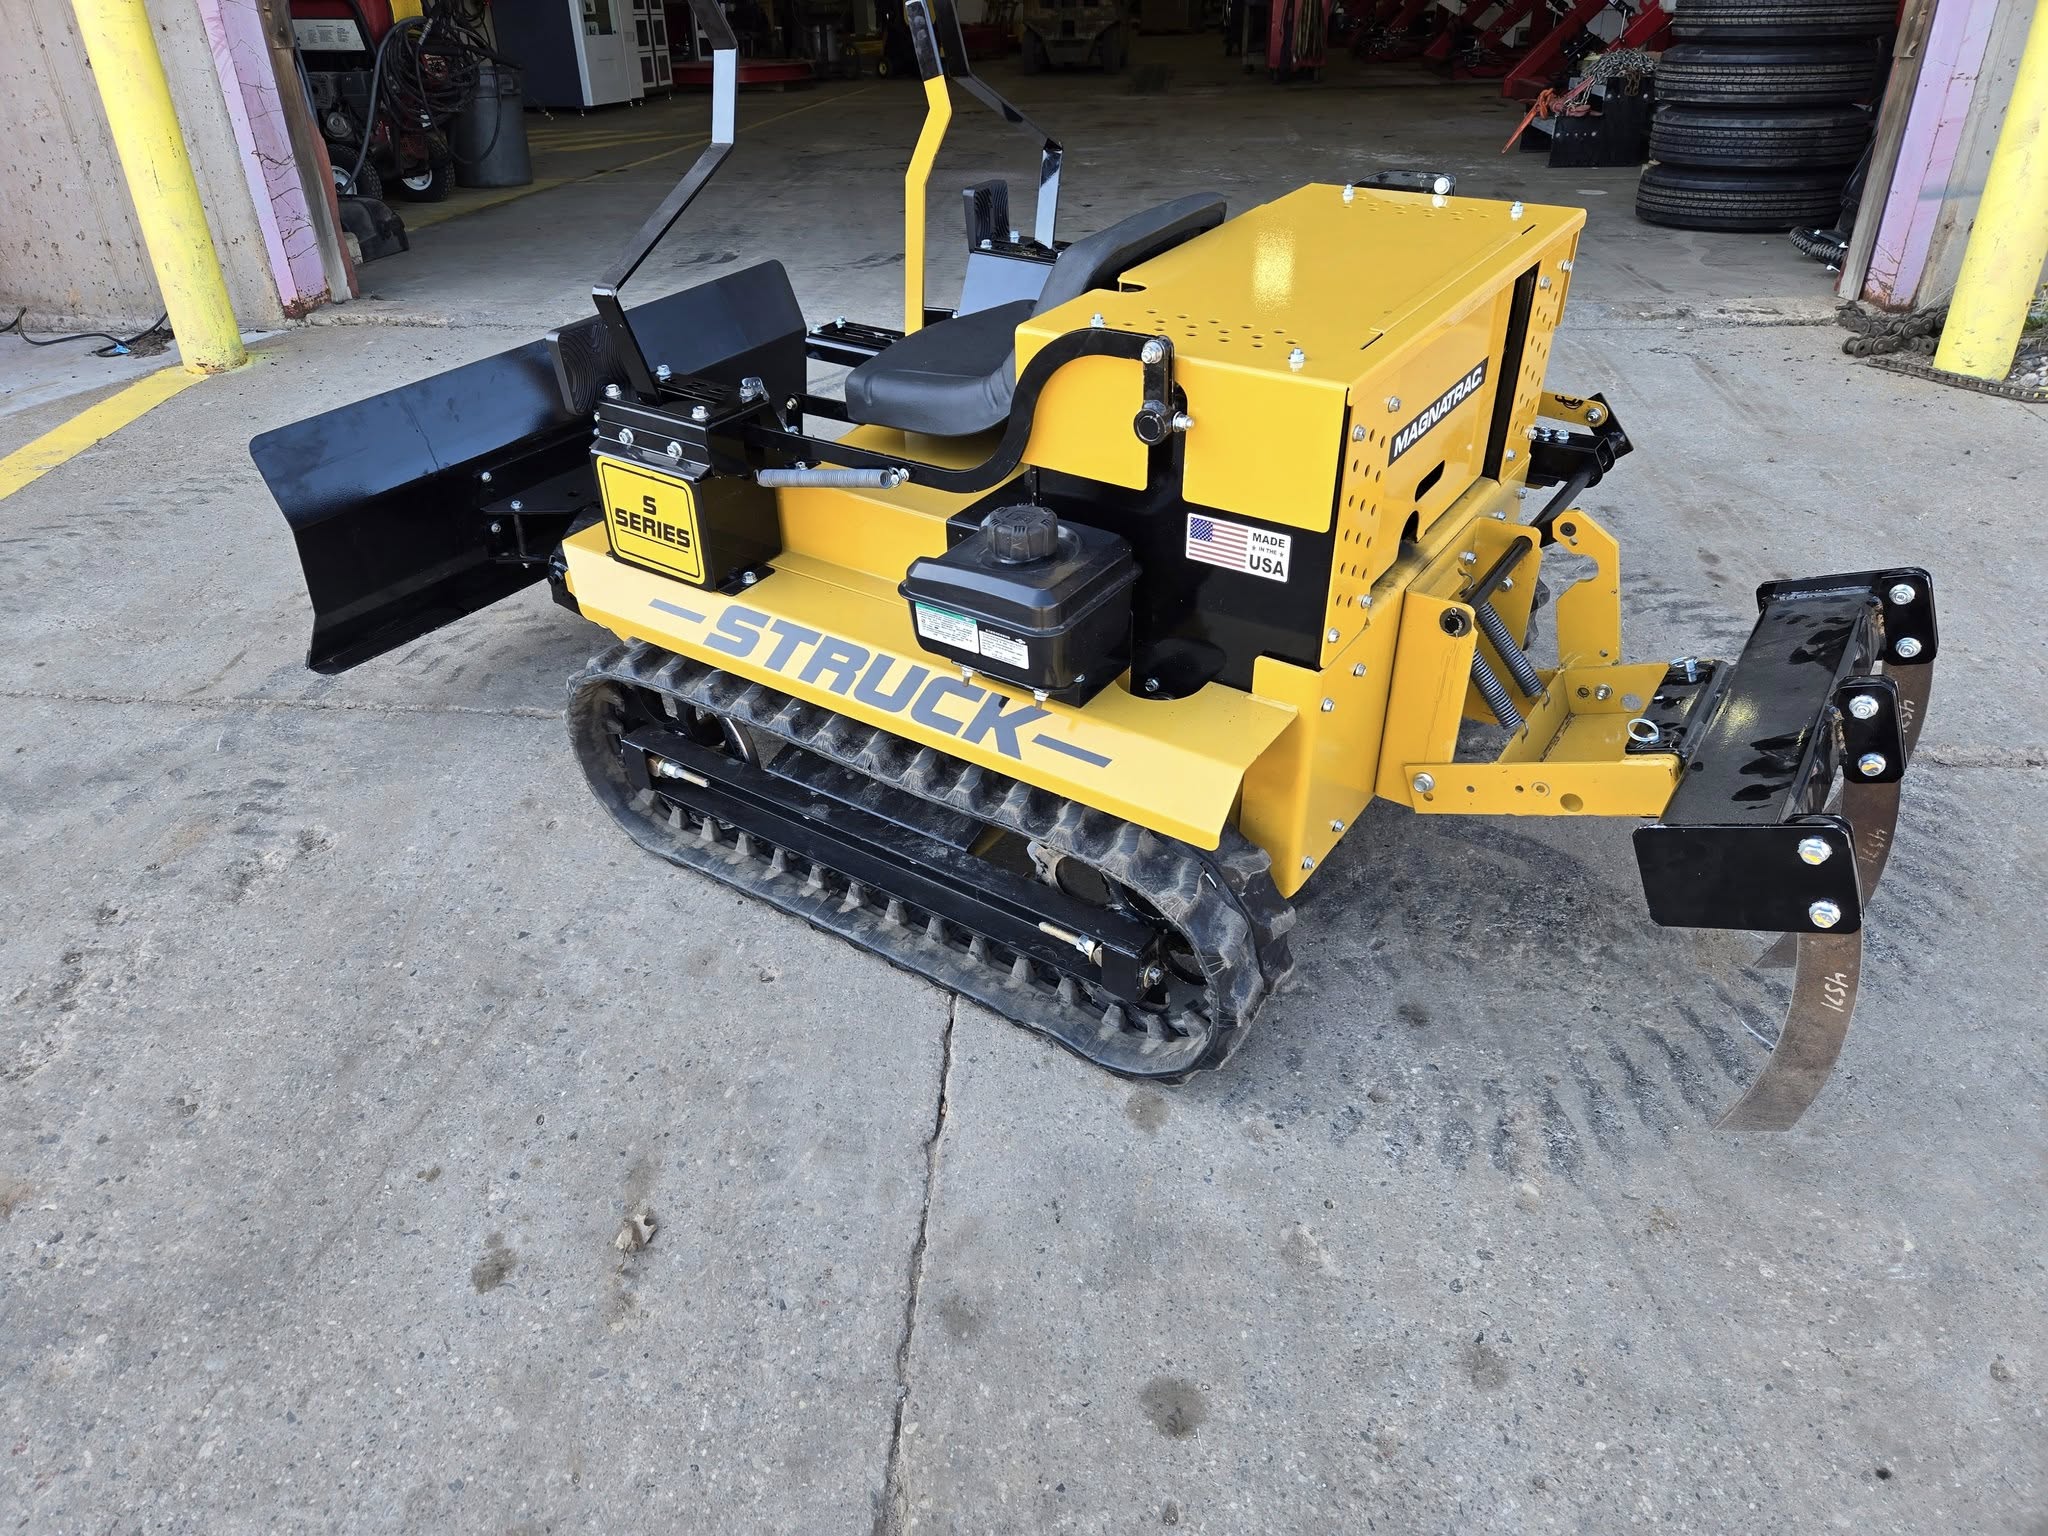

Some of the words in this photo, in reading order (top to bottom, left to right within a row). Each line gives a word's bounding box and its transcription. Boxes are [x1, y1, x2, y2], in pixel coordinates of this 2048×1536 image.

[1394, 367, 1482, 457] MAGNATRAC
[643, 495, 657, 516] S
[615, 507, 691, 548] SERIES
[1252, 533, 1285, 548] MADE
[1249, 554, 1284, 577] USA
[702, 605, 1052, 760] STRUCK
[1820, 972, 1849, 1013] 4571
